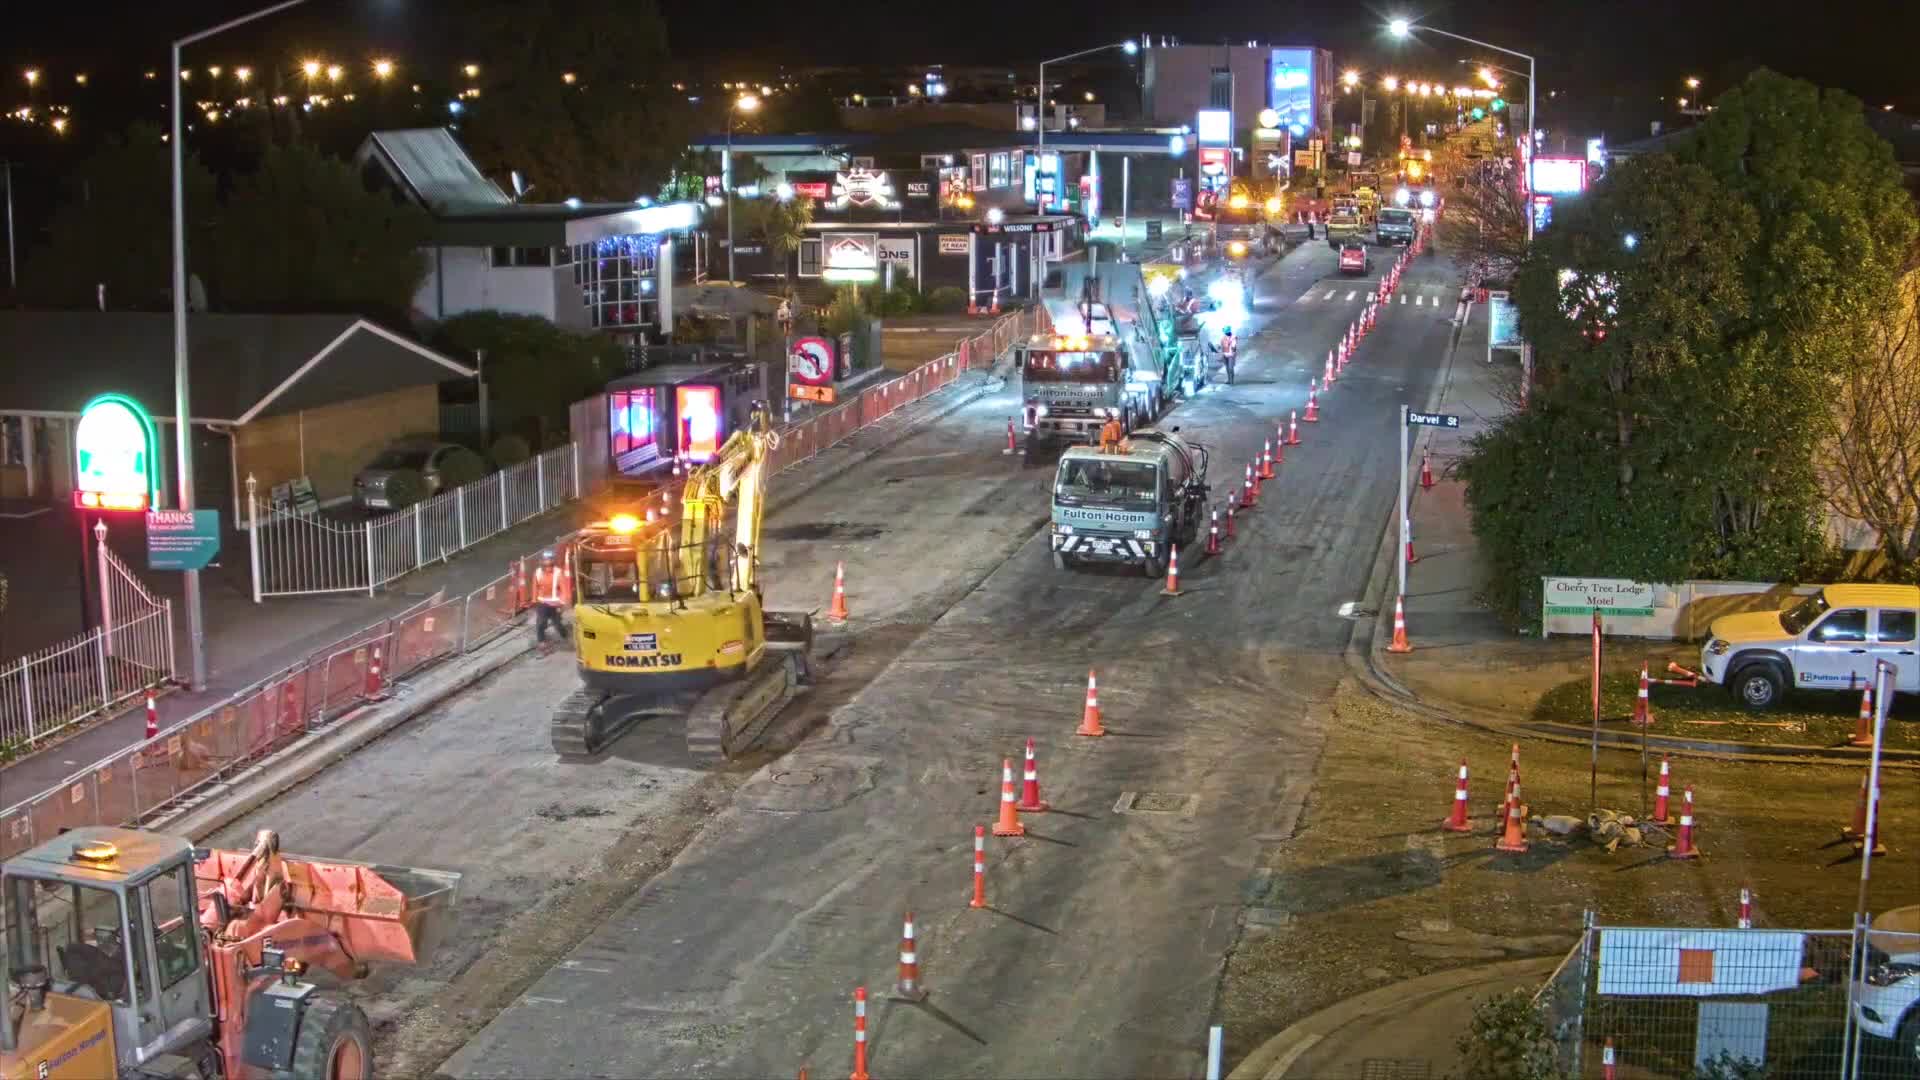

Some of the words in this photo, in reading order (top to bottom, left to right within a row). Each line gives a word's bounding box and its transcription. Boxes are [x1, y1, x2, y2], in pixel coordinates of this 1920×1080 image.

[1410, 413, 1440, 425] Darvel
[1447, 416, 1458, 426] St
[148, 511, 194, 524] THANKS
[1063, 509, 1102, 520] Fulton
[1105, 512, 1145, 523] Hogan
[1556, 582, 1589, 594] Cherry
[1591, 583, 1613, 593] Tree
[1616, 584, 1645, 595] Lodge
[1586, 596, 1614, 606] Motel
[605, 653, 682, 667] KOMATSU
